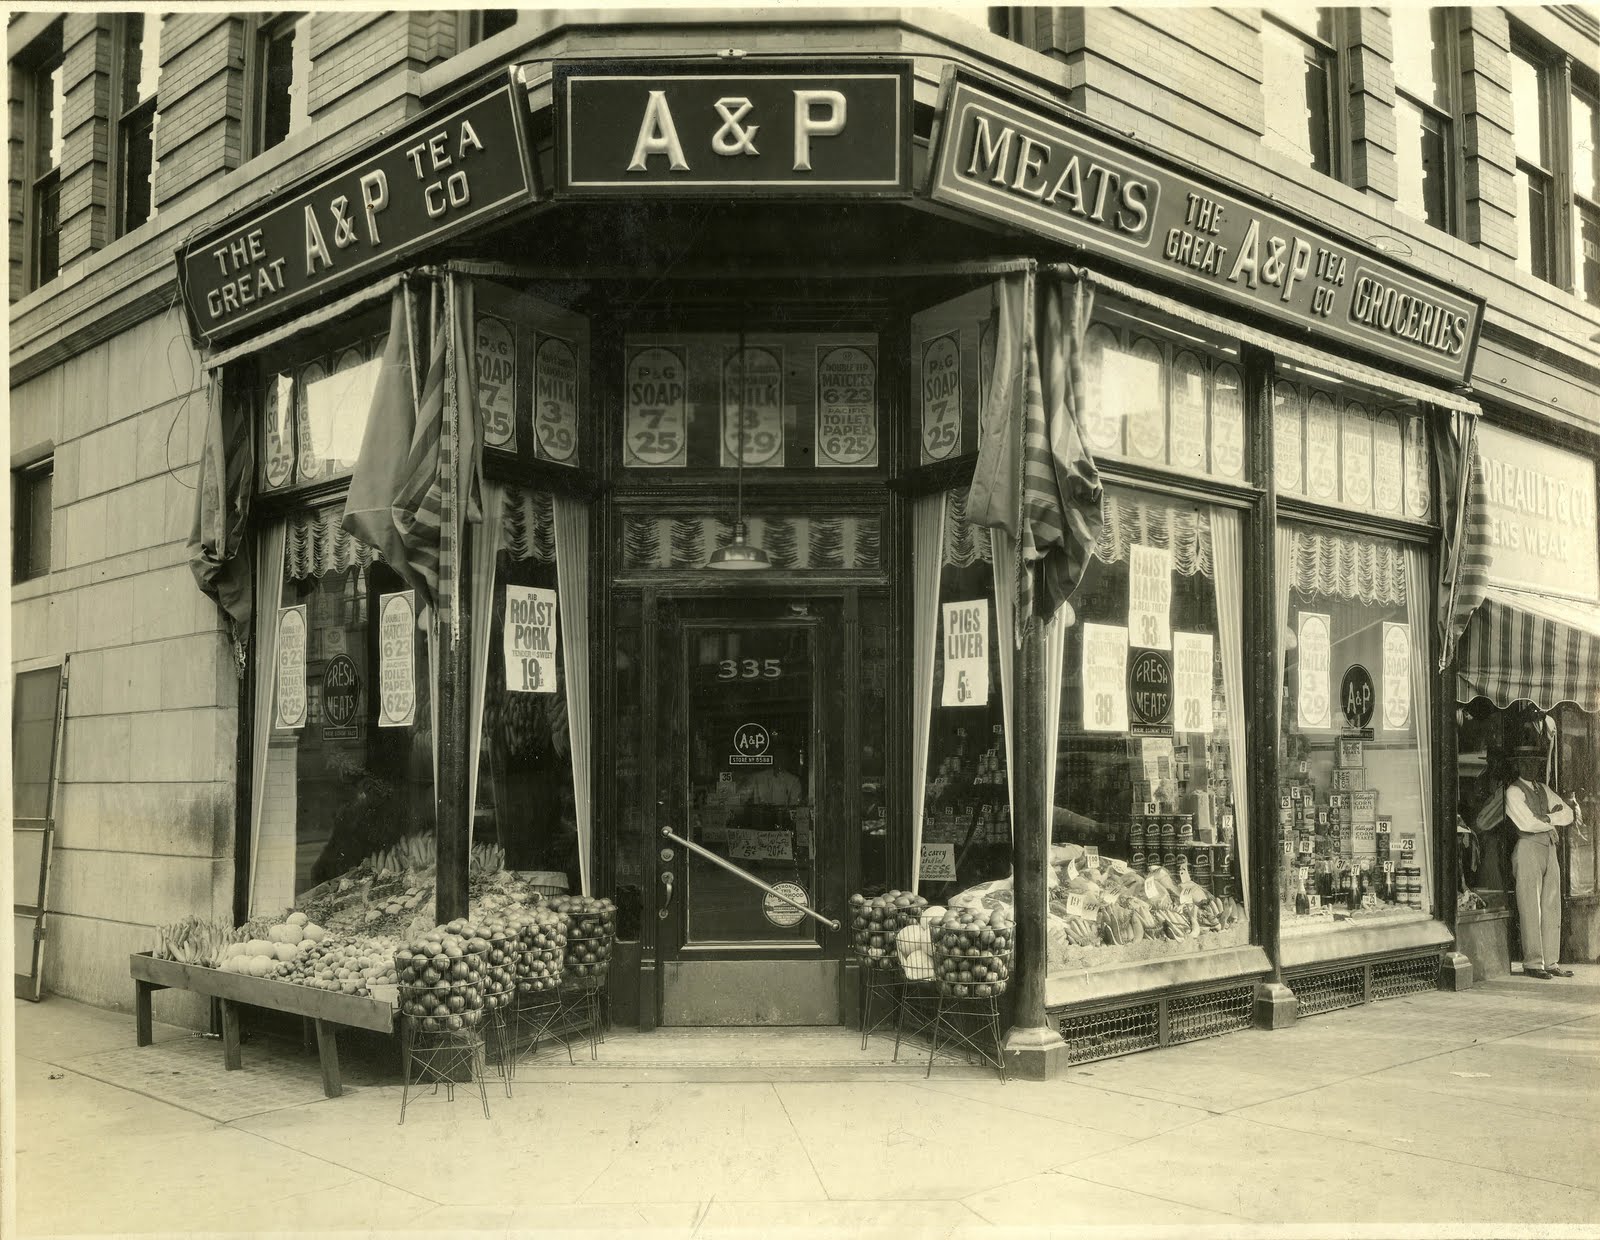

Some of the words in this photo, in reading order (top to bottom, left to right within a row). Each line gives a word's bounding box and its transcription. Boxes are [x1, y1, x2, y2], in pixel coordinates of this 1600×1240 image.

[406, 120, 484, 180] TEA
[967, 115, 1149, 234] MEATS
[424, 169, 471, 219] CO
[1186, 192, 1225, 236] THE
[213, 228, 266, 278] THE
[1165, 227, 1228, 276] GREAT
[1315, 247, 1347, 287] TEA
[206, 257, 286, 319] GREAT
[1312, 285, 1336, 318] CO
[1351, 275, 1467, 356] GROCERIES
[822, 373, 873, 387] MATCHES
[926, 371, 958, 403] SOAP
[631, 383, 683, 407] SOAP
[268, 407, 291, 434] SOP
[823, 414, 871, 425] TOILET
[823, 425, 872, 436] PAPER
[541, 424, 572, 451] 29
[634, 431, 679, 454] 25
[1523, 526, 1569, 562] WEAR
[527, 593, 538, 601] RIB
[1133, 576, 1168, 603] HAMS
[511, 598, 553, 627] ROAST
[950, 607, 981, 635] PIGS
[514, 624, 550, 651] PORK
[1141, 614, 1157, 646] 33
[536, 651, 553, 660] SWEET
[948, 632, 983, 660] LIVER
[327, 661, 355, 688] FRESH
[384, 667, 409, 680] TOILET
[521, 658, 540, 691] 19
[718, 659, 782, 679] 335
[1136, 659, 1168, 685] FRESH
[1178, 649, 1210, 674] CURED
[281, 675, 302, 687] TOILET
[281, 686, 302, 698] PAPER
[384, 680, 411, 692] PAPER
[327, 694, 354, 721] MEATS
[1136, 691, 1167, 718] MEATS
[1347, 682, 1371, 714] A&P
[1184, 697, 1201, 729] 28
[739, 733, 765, 749] A&P
[722, 773, 731, 782] 35
[1147, 803, 1156, 814] 19
[1379, 823, 1388, 832] 19
[927, 850, 947, 861] carry
[1402, 839, 1414, 850] 29
